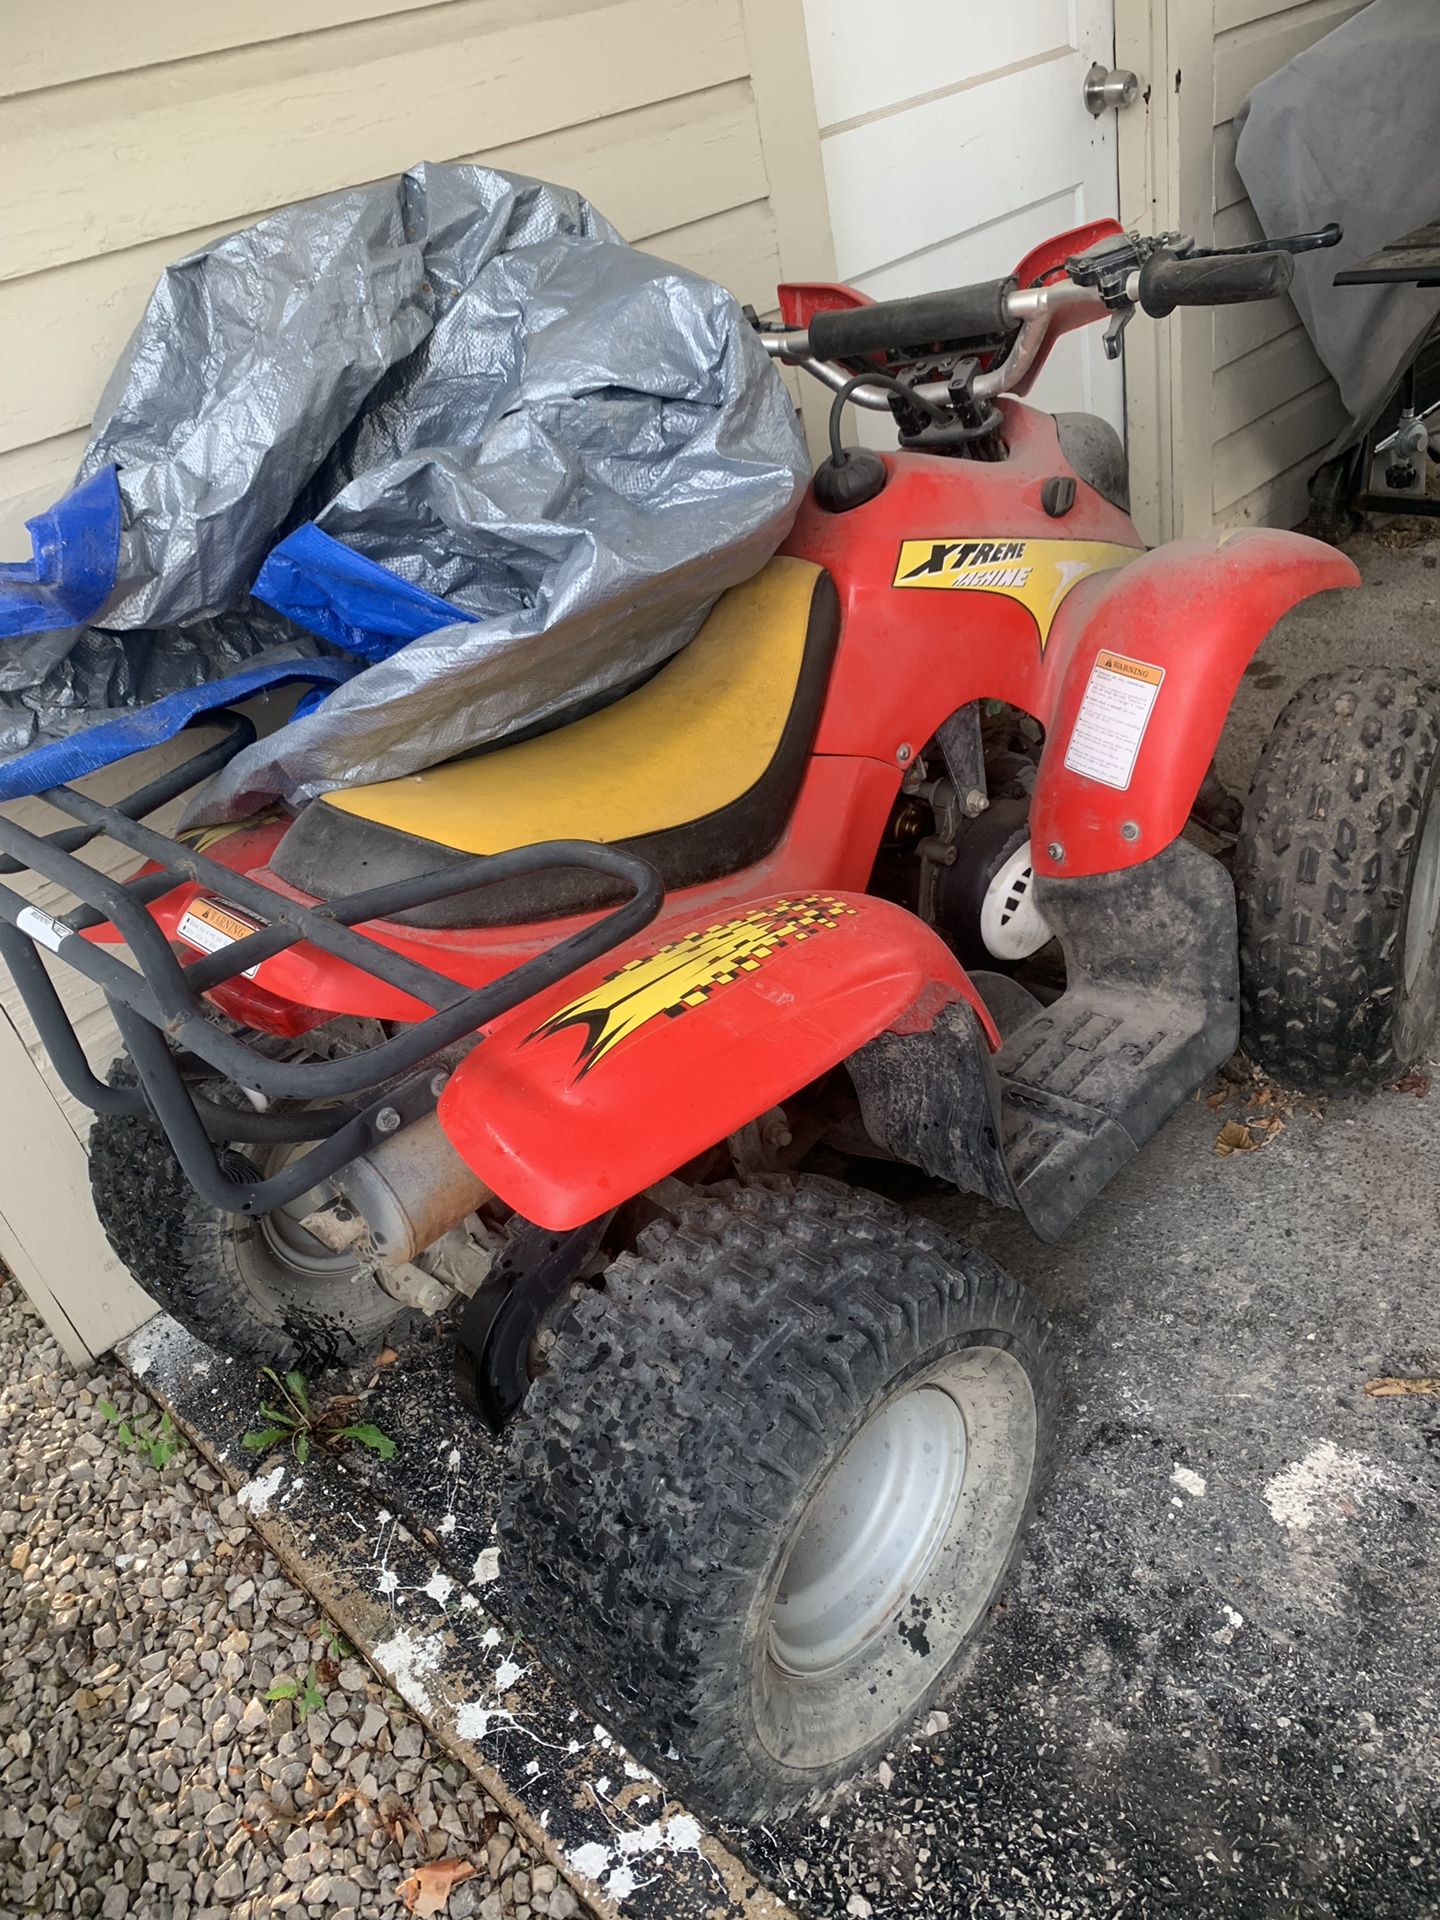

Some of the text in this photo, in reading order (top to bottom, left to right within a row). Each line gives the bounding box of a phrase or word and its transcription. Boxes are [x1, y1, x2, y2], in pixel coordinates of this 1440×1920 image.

[900, 543, 1026, 580] XTREME
[952, 568, 1033, 587] MACHINE
[1113, 661, 1149, 678] WARNING
[210, 909, 246, 937] WARNING
